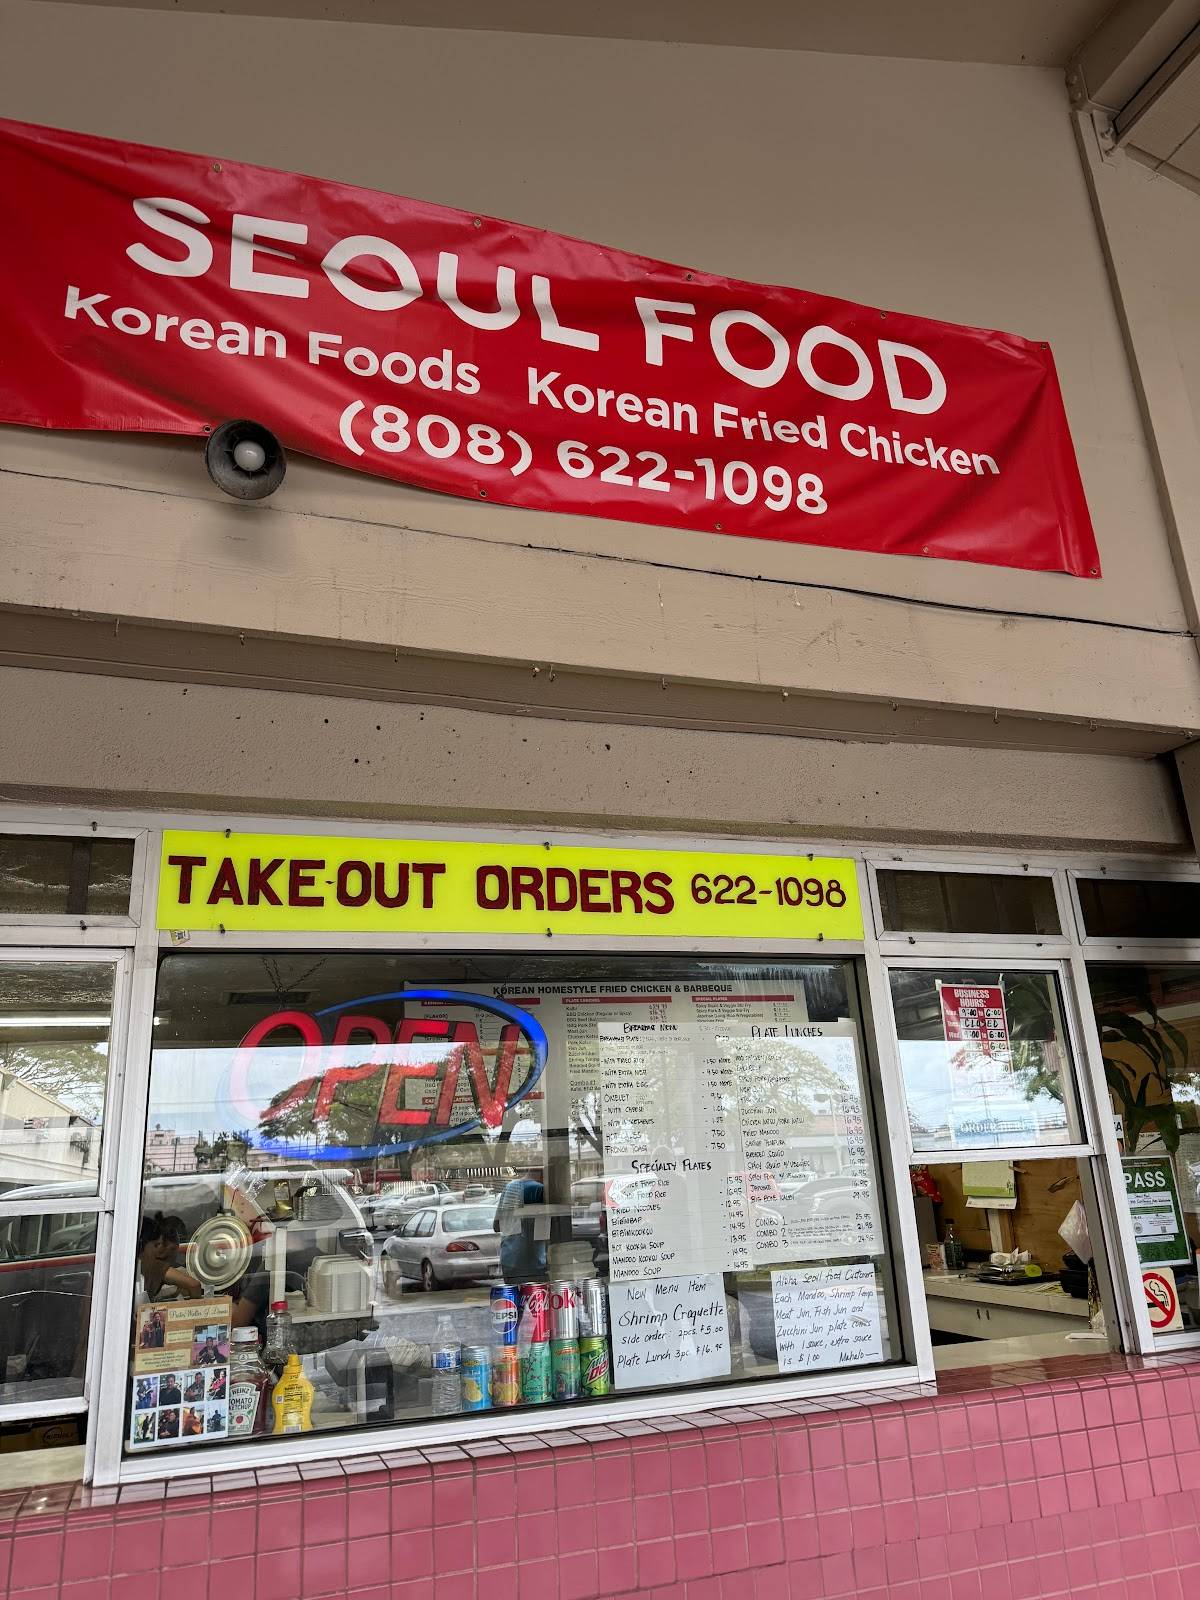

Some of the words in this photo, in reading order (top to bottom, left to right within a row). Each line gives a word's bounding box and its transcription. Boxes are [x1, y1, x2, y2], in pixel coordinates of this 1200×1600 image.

[126, 197, 599, 351] SEOUL
[635, 296, 947, 415] FOOD
[64, 285, 287, 359] Korean
[308, 331, 482, 395] Foods
[527, 368, 698, 435] Korean
[713, 403, 828, 450] Fried
[840, 423, 1000, 477] Chicken
[338, 400, 534, 477] (808)
[557, 440, 828, 515] 622-1098
[168, 855, 447, 909] TAKE-OUT
[476, 864, 675, 915] ORDERS
[691, 873, 848, 908] 622-1098
[493, 986, 534, 995] KOREAN
[537, 985, 597, 994] HOMESTYLE
[600, 985, 627, 993] FRIED
[630, 985, 673, 993] CHICKEN
[674, 985, 681, 993] &
[954, 988, 990, 999] BUSINESS
[959, 998, 987, 1008] HOURS:
[751, 1025, 779, 1041] PLATE
[784, 1024, 824, 1038] LUNCHES
[229, 1010, 522, 1129] OPEN
[682, 1158, 712, 1173] PLATES
[1123, 1170, 1166, 1189] PASS
[654, 1190, 667, 1198] RICE
[754, 1218, 779, 1229] COMBO
[781, 1216, 788, 1226] 1
[756, 1228, 778, 1238] COMBO
[780, 1228, 787, 1237] 2
[649, 1241, 665, 1250] SOUP
[756, 1241, 779, 1250] COMBO
[781, 1239, 789, 1249] 3
[660, 1252, 676, 1261] SOUP
[643, 1266, 662, 1276] SOUP
[655, 1283, 679, 1296] Menu
[687, 1280, 708, 1293] Item
[774, 1292, 792, 1304] Each
[829, 1287, 856, 1301] Shrimp
[492, 1311, 517, 1320] PEPSI
[775, 1307, 795, 1320] Meat
[814, 1305, 831, 1317] Fish
[833, 1304, 847, 1316] Jun
[851, 1301, 865, 1313] and
[618, 1310, 668, 1327] Shrimp
[776, 1324, 808, 1338] Zucchini
[809, 1322, 824, 1334] Jun
[827, 1319, 848, 1336] plate
[620, 1333, 641, 1345] side
[616, 1353, 641, 1369] Plate
[645, 1348, 671, 1364] Lunch
[783, 1354, 793, 1366] is
[228, 1397, 253, 1406] TOMATO
